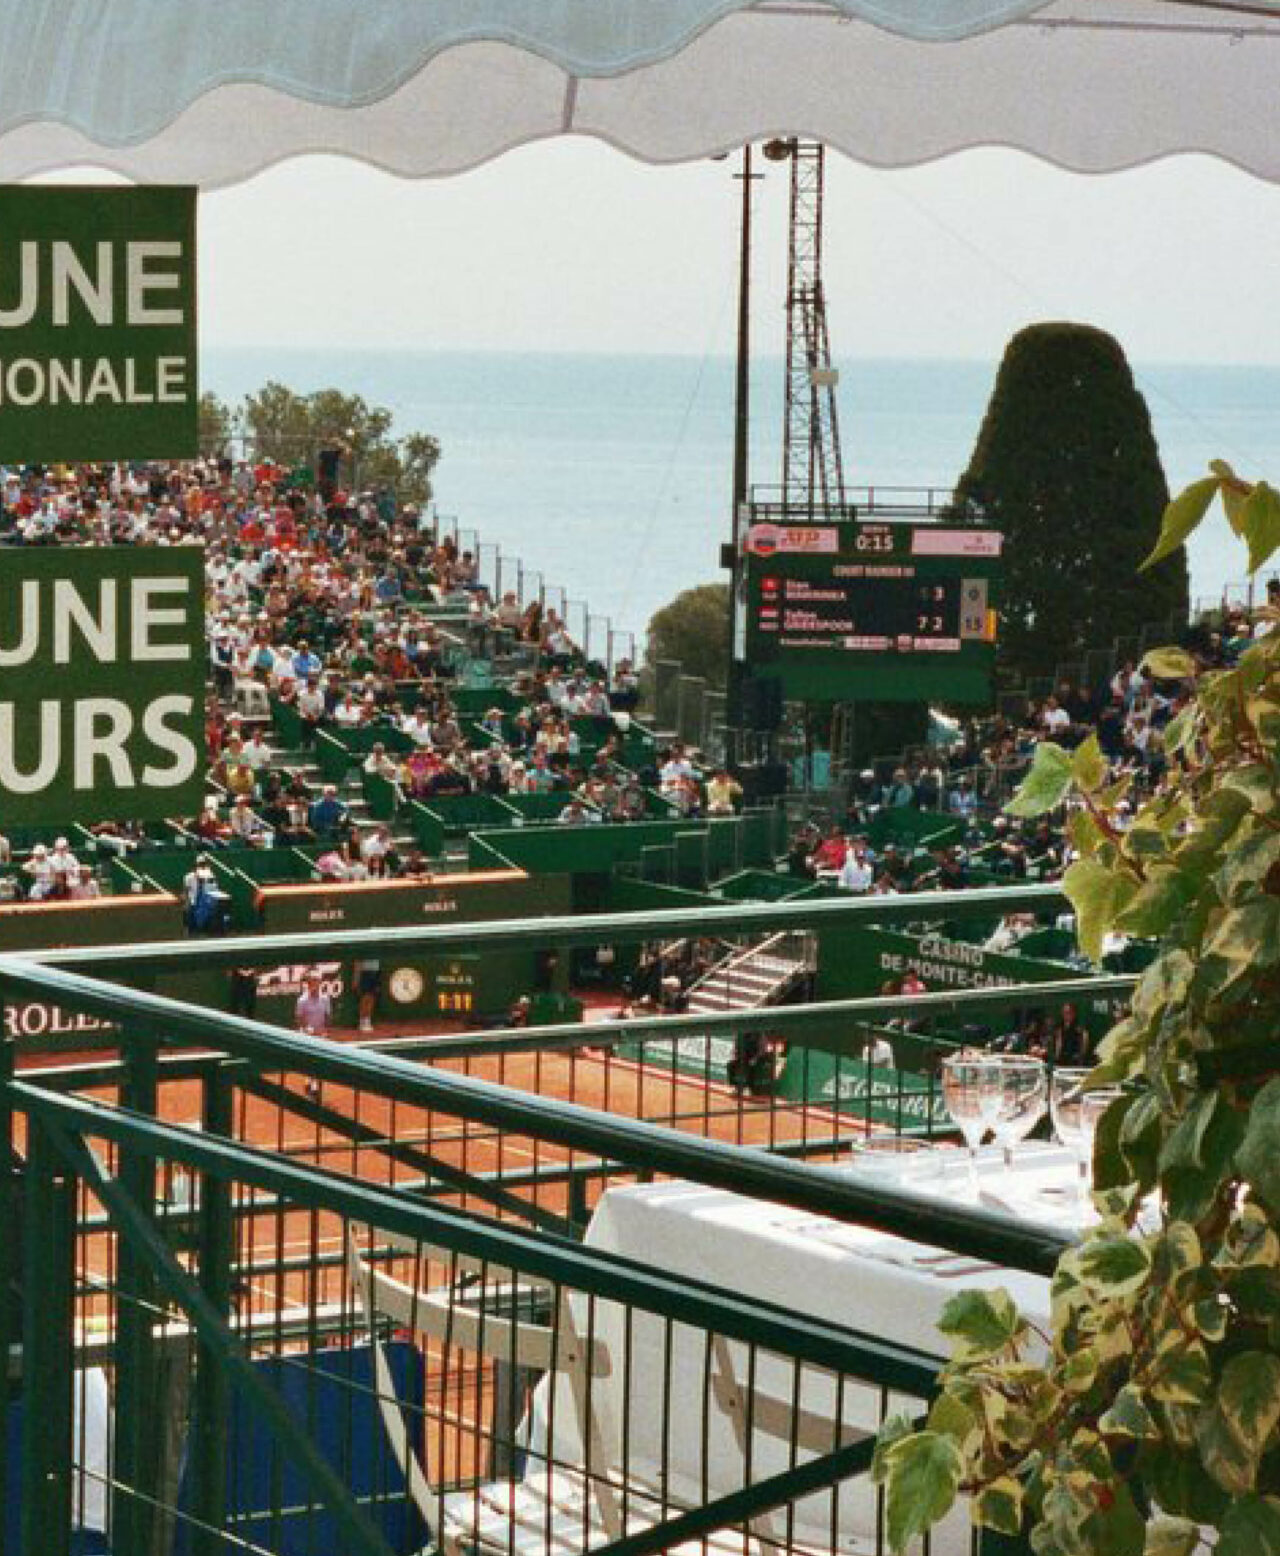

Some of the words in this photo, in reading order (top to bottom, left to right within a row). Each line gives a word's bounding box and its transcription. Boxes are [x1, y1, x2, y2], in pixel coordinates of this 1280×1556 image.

[855, 535, 894, 551] 0:15
[920, 938, 984, 967] CASINO
[880, 952, 903, 972] DE
[907, 956, 1030, 990] MONTE-CAR
[3, 1003, 122, 1036] ROLE
